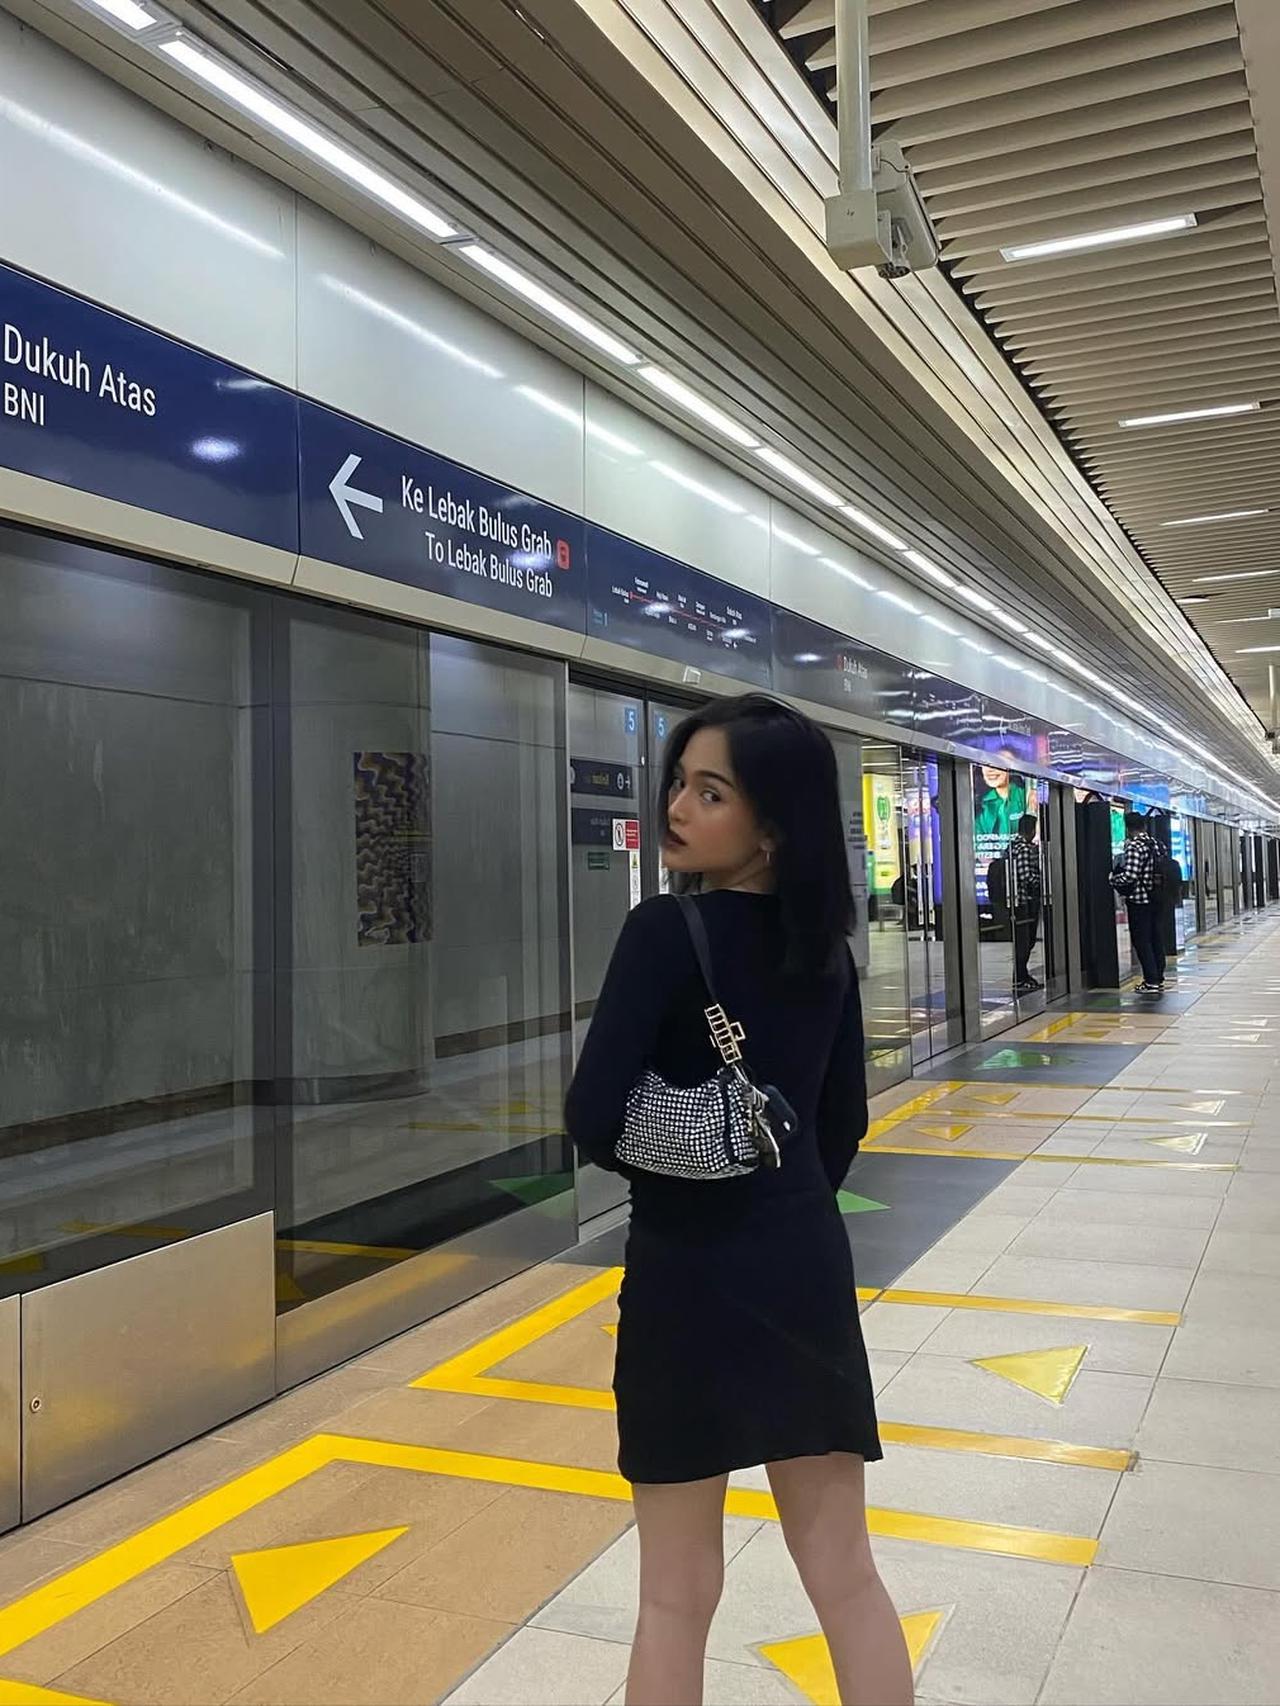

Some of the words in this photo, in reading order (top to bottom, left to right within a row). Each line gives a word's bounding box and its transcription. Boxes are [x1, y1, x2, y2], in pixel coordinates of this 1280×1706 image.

[4, 323, 91, 392] Dukuh
[99, 365, 156, 416] Atas
[4, 382, 45, 426] BNI
[402, 475, 424, 513] Ke
[429, 487, 476, 533] Lebak
[479, 506, 518, 549] Bulus
[520, 523, 552, 561] Grab
[425, 531, 445, 564] To
[448, 539, 487, 578] Lebak
[489, 553, 523, 589] Bulus
[526, 568, 553, 597] Grab
[629, 711, 635, 731] 5
[658, 717, 665, 737] 5
